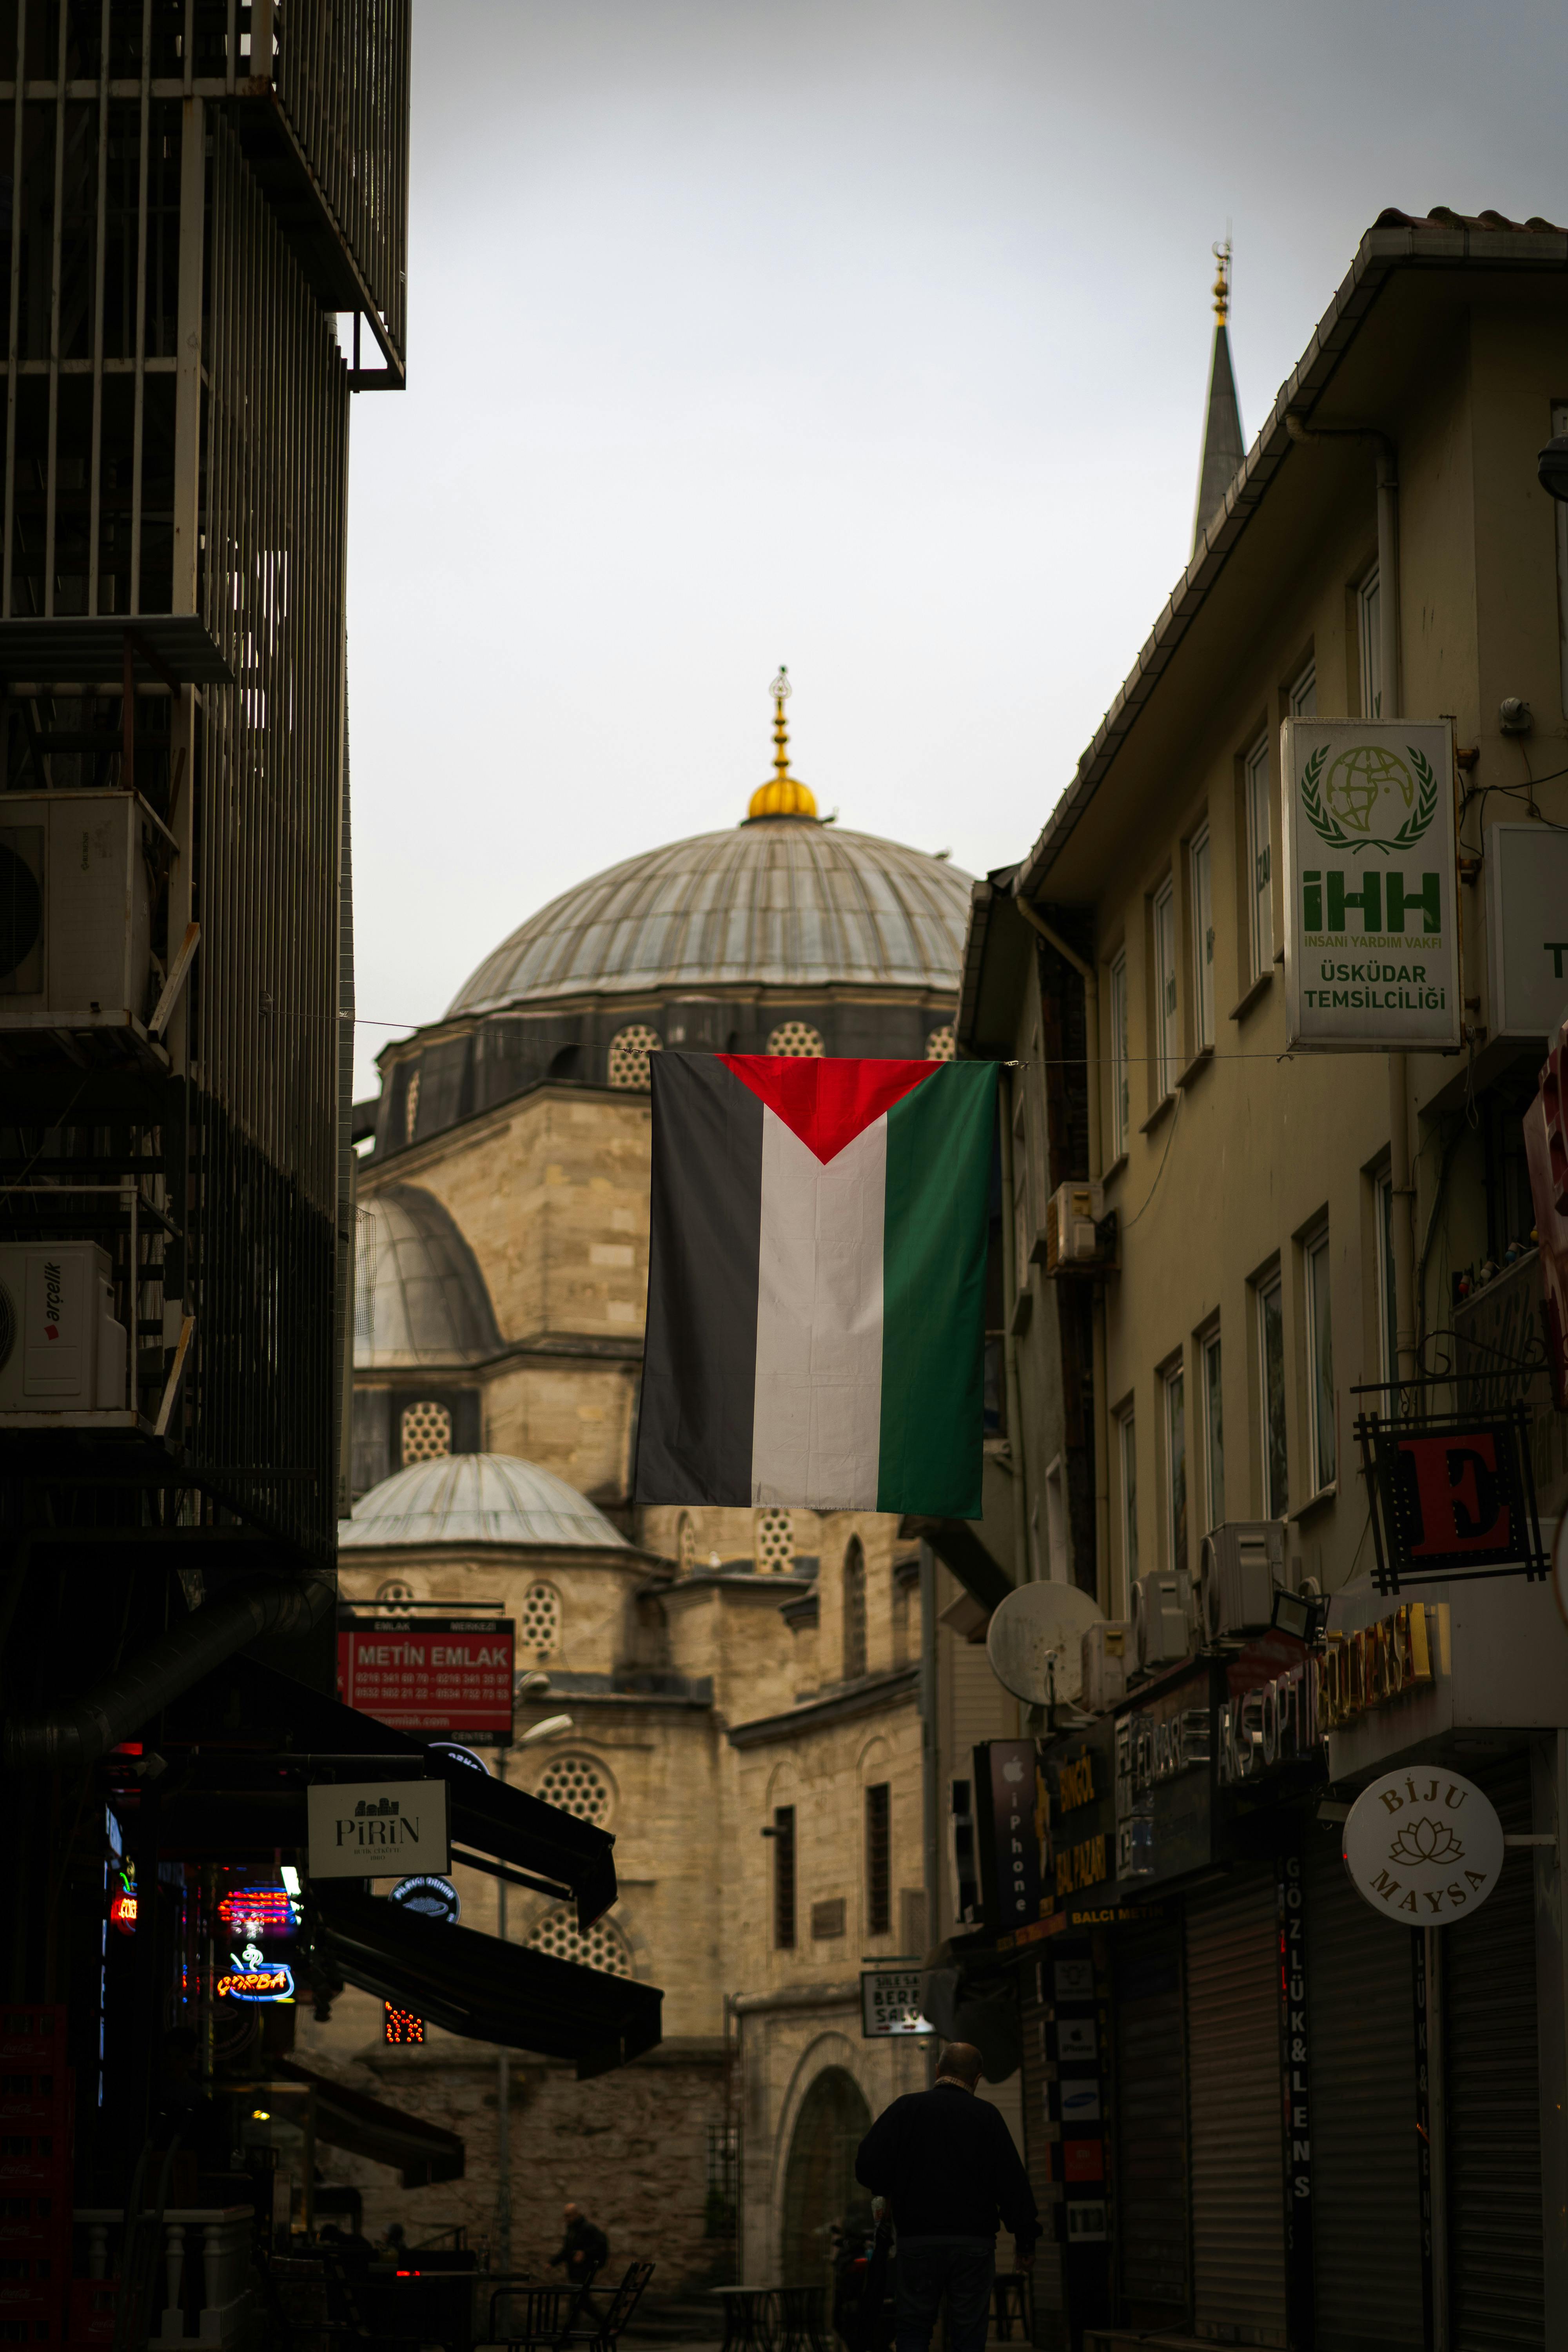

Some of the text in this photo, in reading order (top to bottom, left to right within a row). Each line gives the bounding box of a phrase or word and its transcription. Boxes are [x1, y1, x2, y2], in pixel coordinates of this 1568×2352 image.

[1350, 936, 1402, 948] YARDIM
[1405, 936, 1442, 949] VAKFI
[1321, 959, 1426, 983] ÜSKÜDAR
[1304, 986, 1445, 1010] TEMSİLCİLİĞİ
[44, 1262, 64, 1321] arçelik
[374, 1622, 410, 1631] EMLAK
[358, 1641, 508, 1667] METİN EMLAK
[452, 1732, 493, 1740] CENTER
[1378, 1777, 1468, 1815] BİJU
[1010, 1791, 1027, 1911] iPhone
[1369, 1868, 1487, 1913] MAYSA
[1072, 1909, 1114, 1924] BALCI
